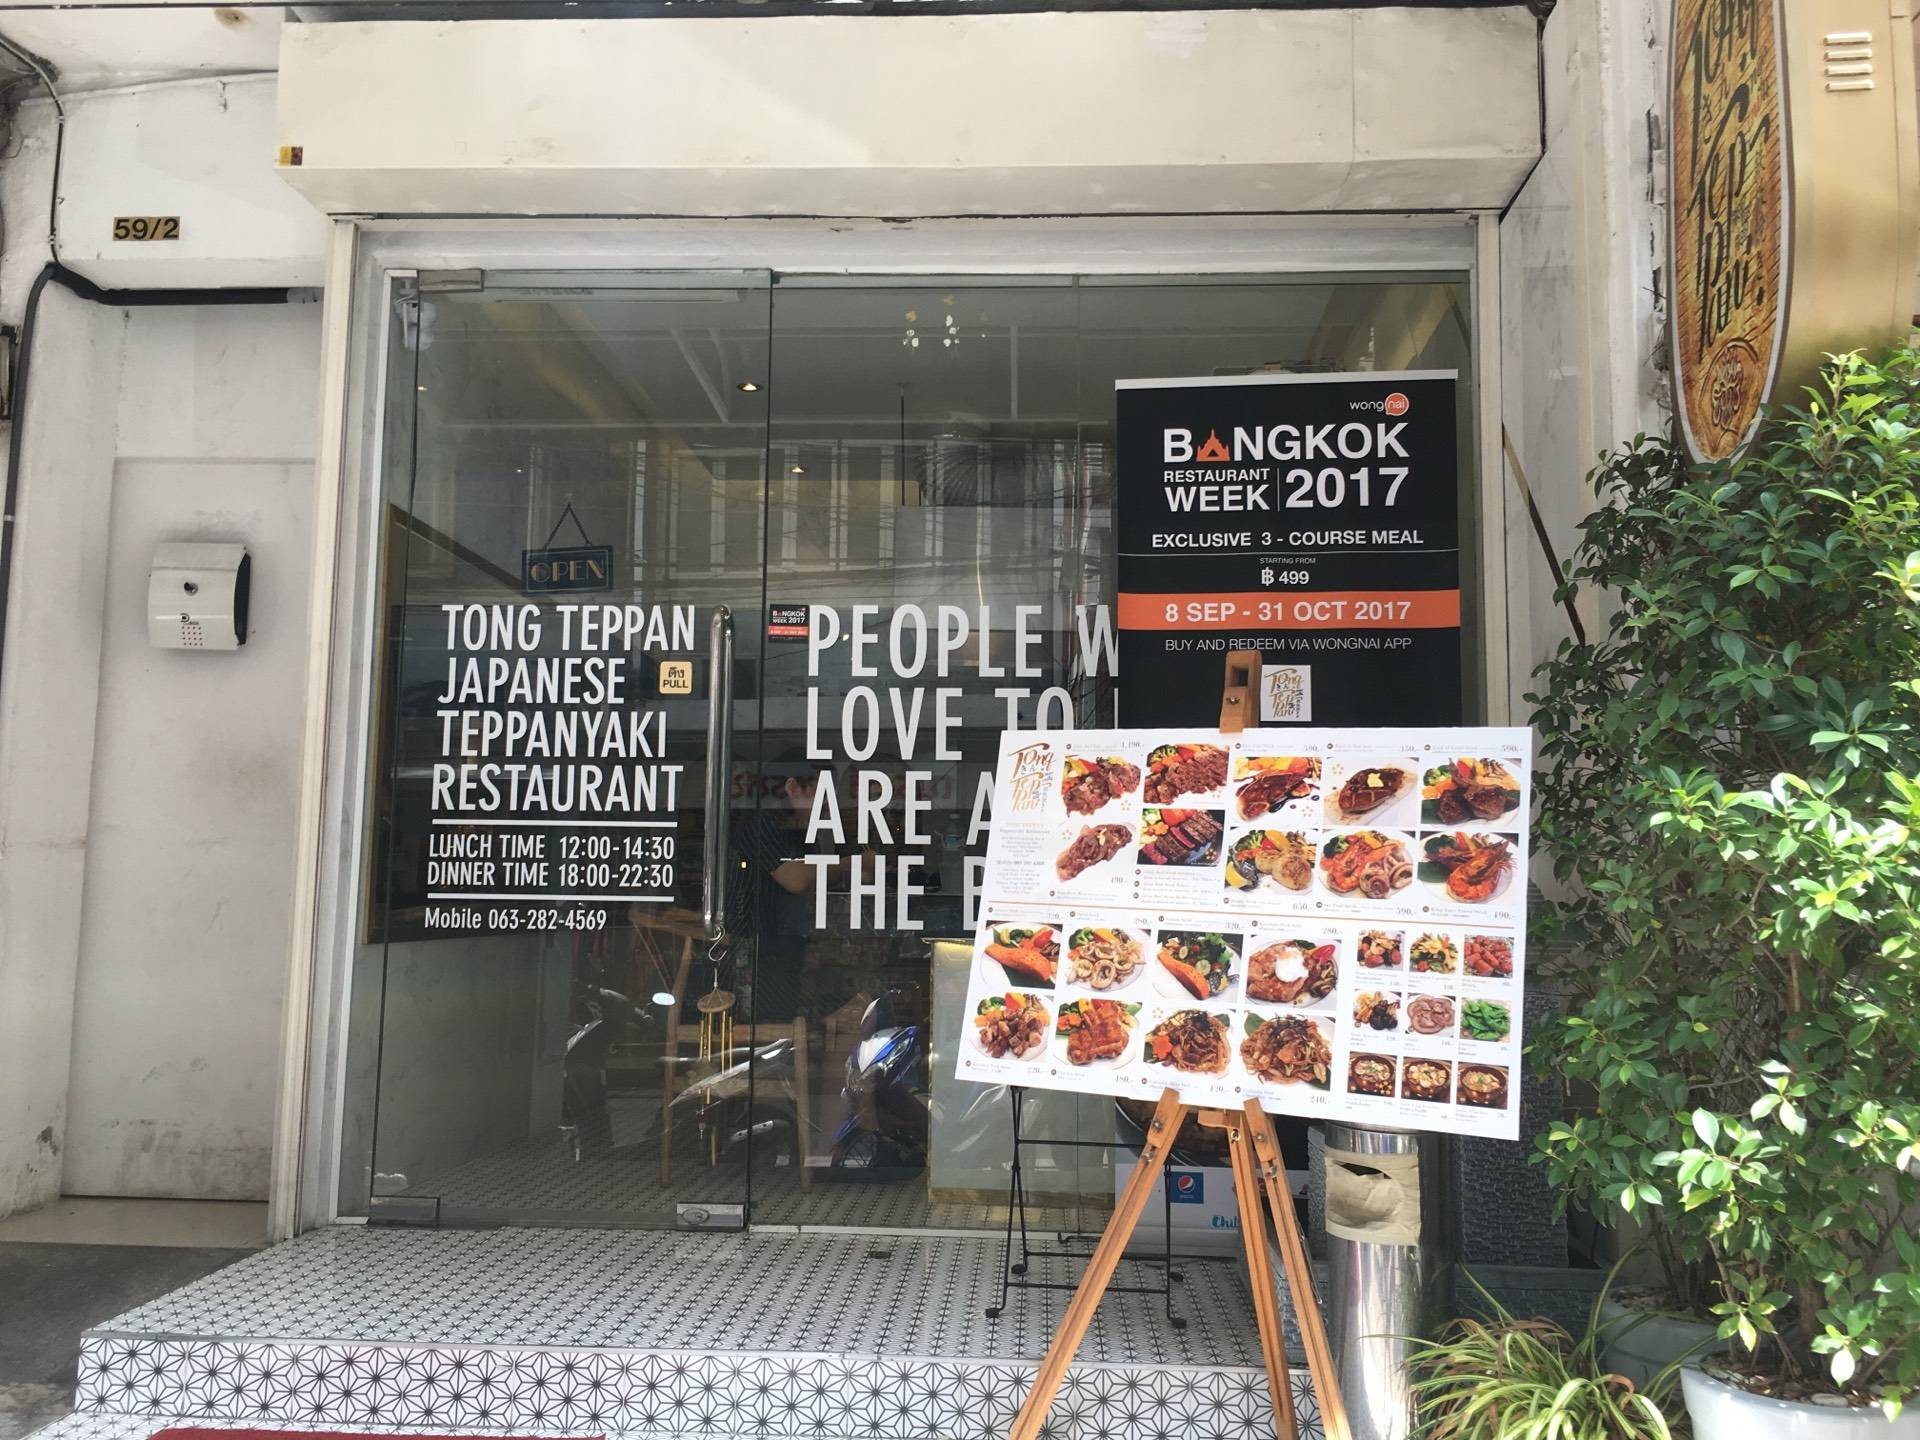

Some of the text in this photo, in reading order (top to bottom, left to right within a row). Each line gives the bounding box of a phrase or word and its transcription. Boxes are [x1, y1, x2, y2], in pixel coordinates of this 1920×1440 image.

[114, 218, 179, 240] 59/2
[1164, 422, 1410, 463] BANGKOK
[1164, 468, 1270, 483] RESTAURANT
[1165, 467, 1410, 512] WEEK 2017
[1152, 533, 1252, 548] EXCLUSIVE
[1261, 533, 1272, 546] 3
[1289, 531, 1367, 546] COURSE
[1371, 530, 1424, 544] MEAL
[531, 560, 604, 582] OPEN
[1279, 570, 1310, 585] 499
[1165, 604, 1179, 622] 8
[1186, 603, 1236, 622] SEP
[1258, 603, 1283, 622] 31
[1293, 601, 1347, 621] OCT
[1355, 601, 1411, 620] 2017
[442, 603, 695, 651] TONG TEPPAN
[808, 604, 1042, 678] PEOPLE
[1165, 637, 1412, 651] BUY AND REDEEM VIA WONGNAI APP
[438, 657, 626, 704] JAPANESE
[663, 679, 688, 688] PULL
[437, 710, 667, 758] TEPPANYAKI
[806, 685, 963, 761] LOVE
[994, 686, 1076, 730] TO
[431, 764, 683, 812] RESTAURANT
[805, 770, 932, 845] ARE
[429, 834, 675, 859] LUNCH TIME 12:00-14:30
[427, 862, 673, 887] DINNER TIME 18:00-22:30
[805, 854, 924, 930] THE
[425, 907, 607, 930] Mobile 063-282-4569
